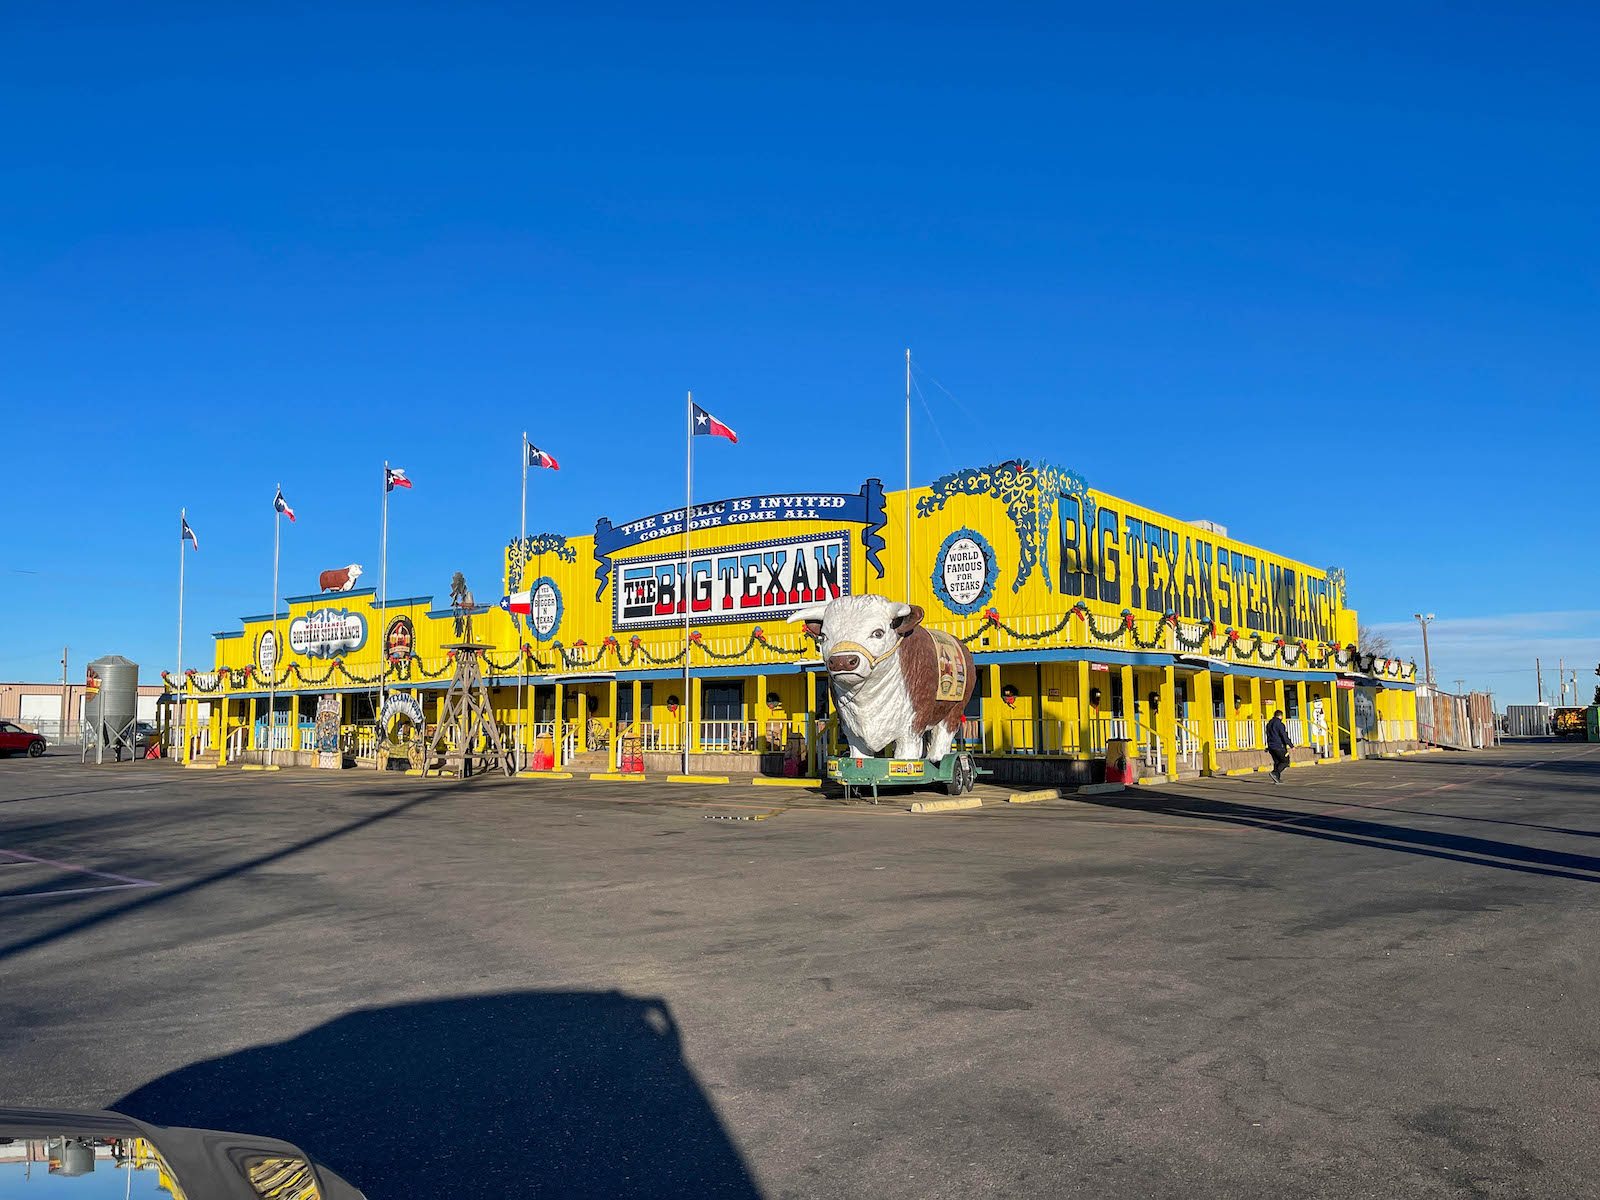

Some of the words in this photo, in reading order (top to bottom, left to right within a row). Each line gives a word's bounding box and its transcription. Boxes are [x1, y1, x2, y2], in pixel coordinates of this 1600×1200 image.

[621, 518, 656, 535] THE
[662, 503, 725, 524] PUBLIC
[732, 499, 752, 511] IS
[759, 496, 846, 509] INVITED
[640, 524, 683, 541] COME
[689, 516, 721, 530] ONE
[727, 510, 777, 523] COME
[783, 509, 820, 519] ALL
[949, 551, 979, 562] WORLD
[946, 561, 982, 573] FAMOUS
[1057, 489, 1121, 605] BIG
[1124, 514, 1216, 624] TEXAN
[1217, 546, 1284, 636] STEAK
[1284, 566, 1337, 643] RANCH
[624, 579, 656, 605] THE
[655, 559, 712, 616] BIG
[717, 543, 841, 610] TEXAN
[956, 573, 973, 581] FOR
[950, 581, 980, 592] STEAKS
[534, 598, 555, 607] BIGGER
[535, 616, 554, 625] TEXAS
[293, 630, 303, 644] BIG
[303, 629, 320, 643] TEXAN
[321, 627, 339, 642] STEAK
[340, 625, 360, 640] RANCH
